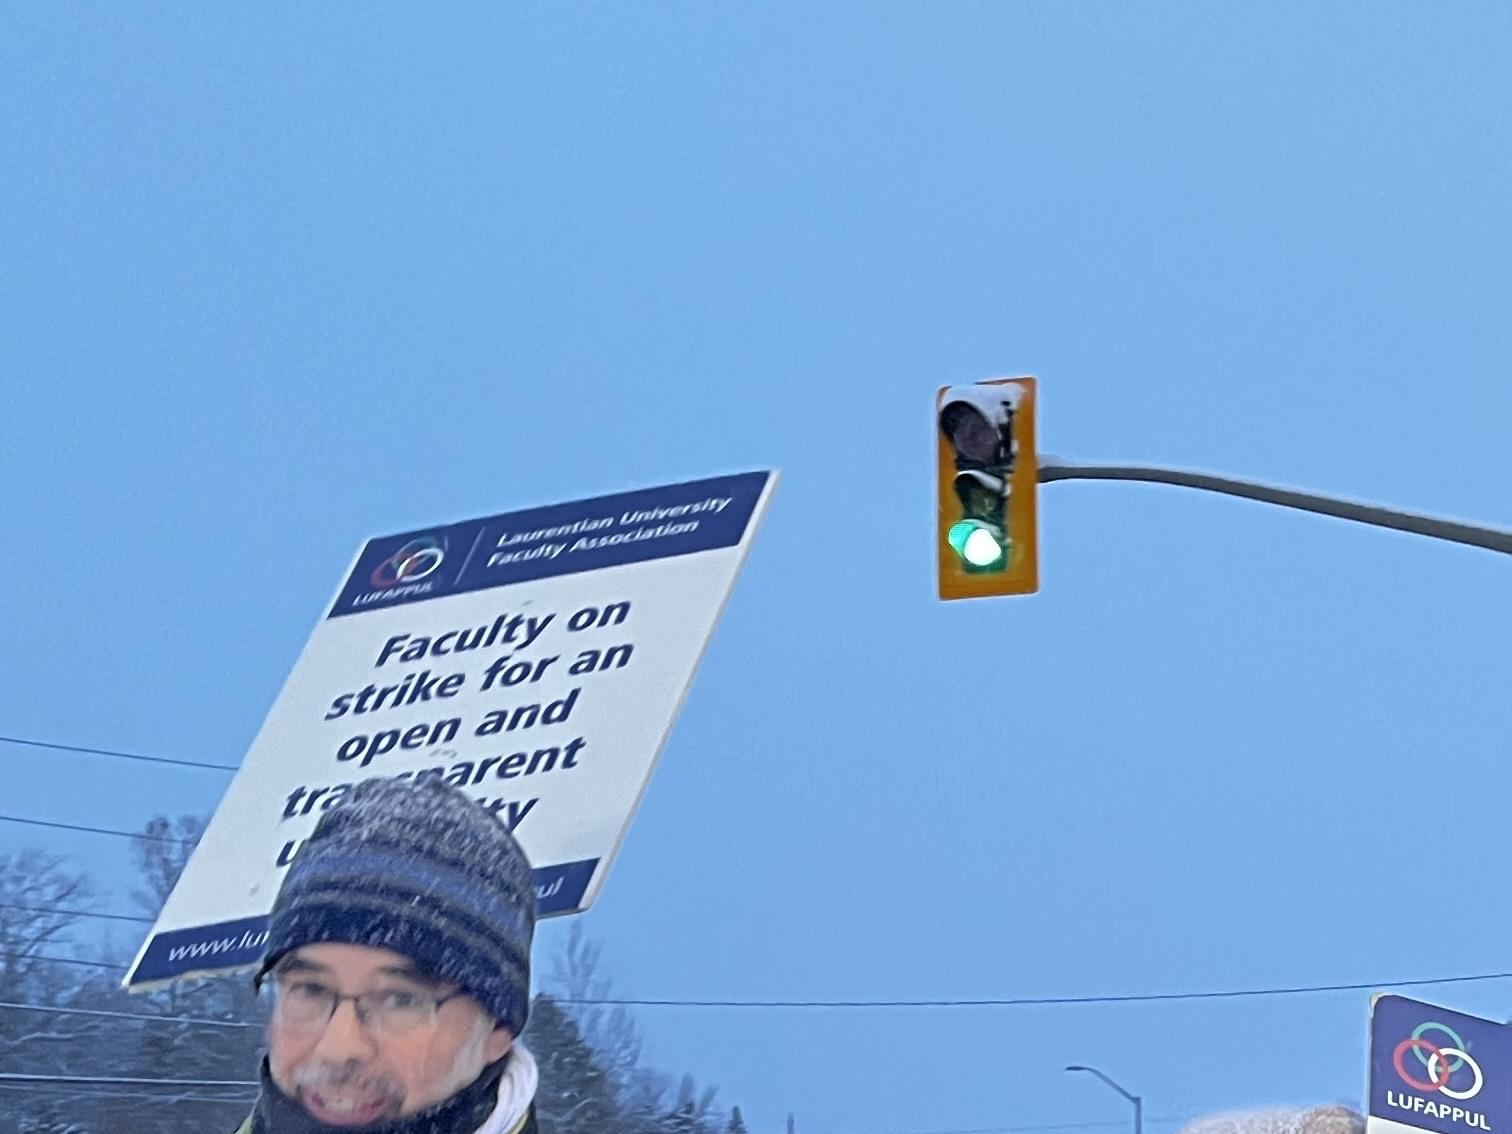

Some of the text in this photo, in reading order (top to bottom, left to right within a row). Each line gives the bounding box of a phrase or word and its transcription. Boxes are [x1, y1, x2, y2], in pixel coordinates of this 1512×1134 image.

[487, 520, 699, 568] Faculty Association
[496, 497, 732, 547] Laurentian University
[374, 599, 632, 669] Faculty on
[324, 640, 634, 722] strike for an
[336, 687, 582, 767] open and
[1386, 1090, 1491, 1131] LUFAPPUL
